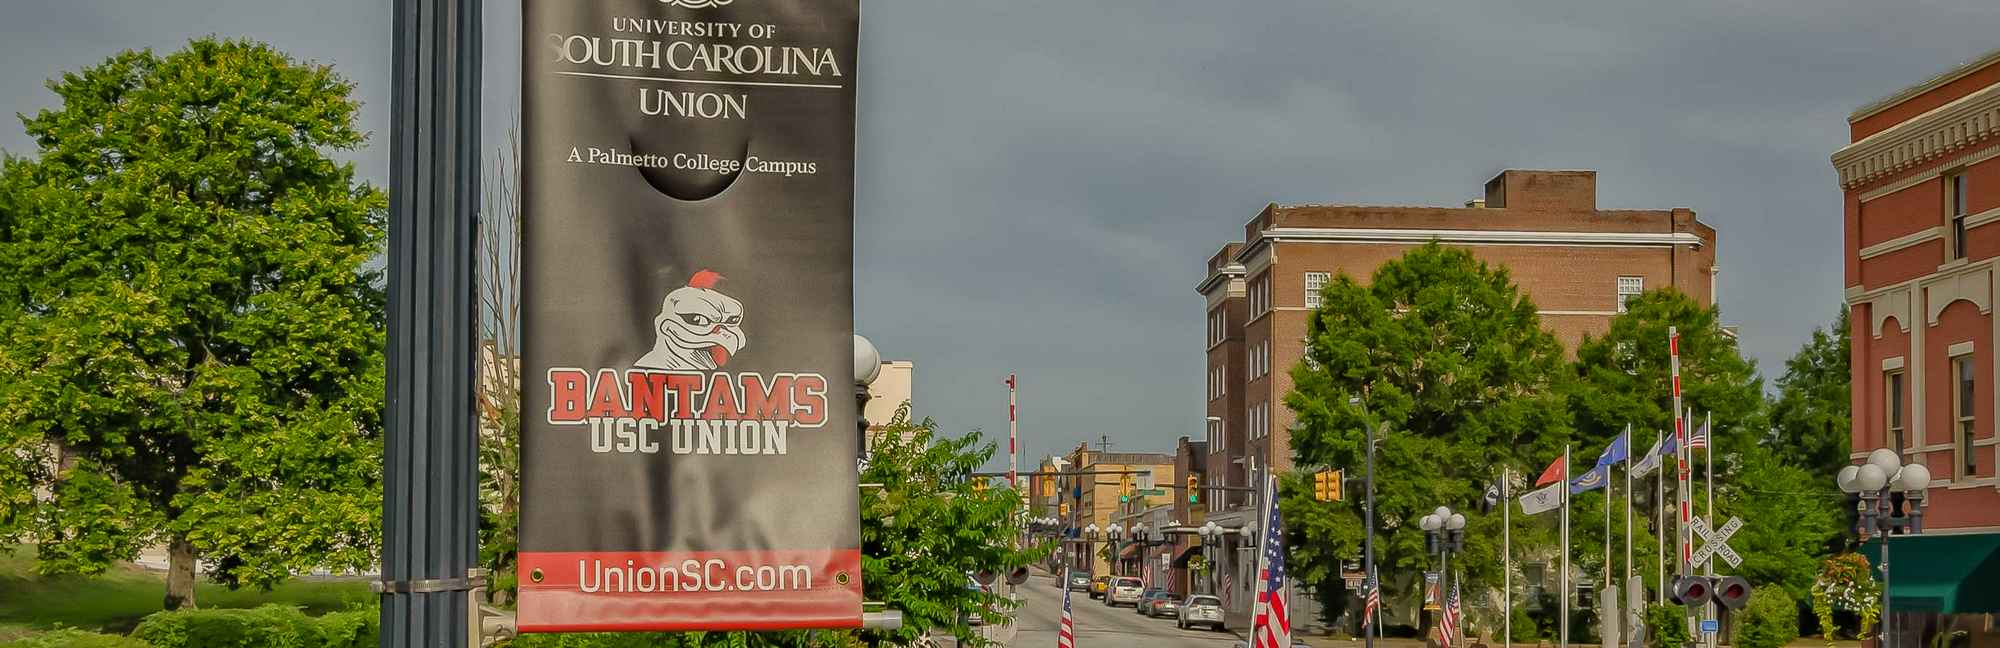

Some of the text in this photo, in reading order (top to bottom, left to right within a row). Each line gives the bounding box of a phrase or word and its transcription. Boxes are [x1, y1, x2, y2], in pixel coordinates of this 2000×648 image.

[613, 17, 775, 39] UNIVERSITY OF
[546, 33, 842, 77] SOUTH CAROLINA
[639, 88, 748, 119] UNION
[568, 147, 817, 176] A Palmetto College Campus
[548, 368, 828, 427] BANTAMS
[591, 417, 789, 455] USC UNION
[1691, 519, 1710, 539] RAIL
[1693, 520, 1738, 563] CROSSING
[1718, 545, 1739, 565] ROAD
[580, 559, 812, 593] UnionSC.com
